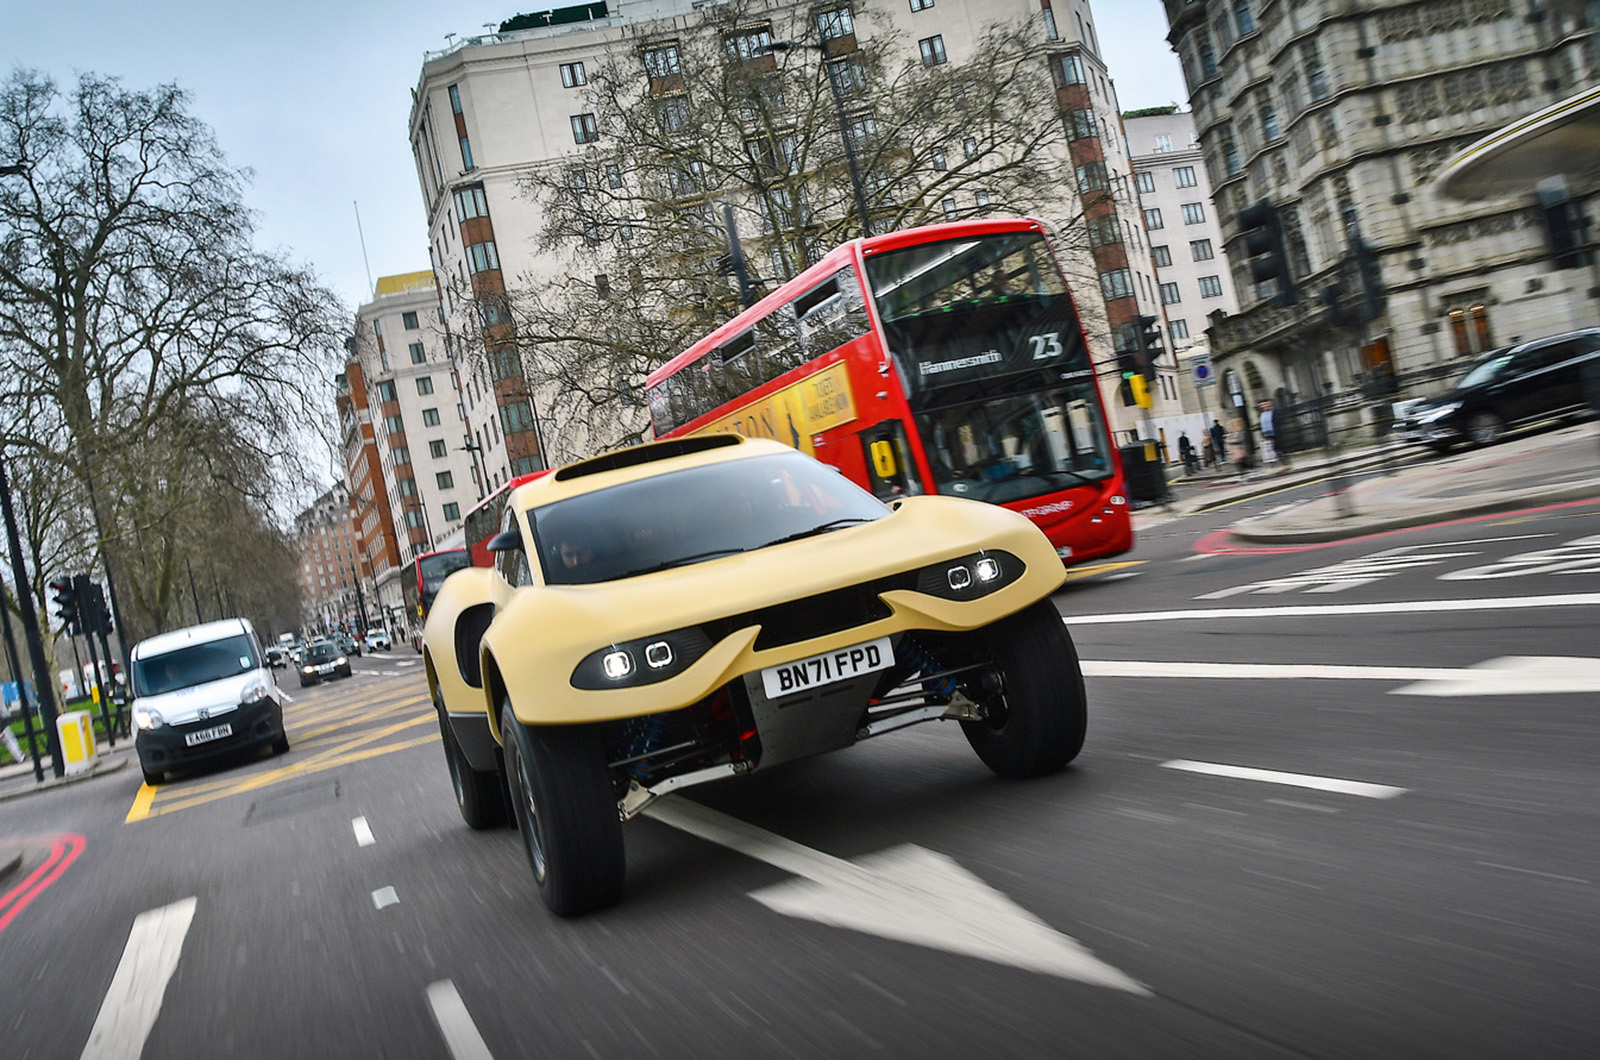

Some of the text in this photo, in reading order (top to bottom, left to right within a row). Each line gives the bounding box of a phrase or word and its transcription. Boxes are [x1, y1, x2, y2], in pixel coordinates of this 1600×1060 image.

[1028, 332, 1063, 361] 23
[777, 645, 881, 692] BN71 FPD
